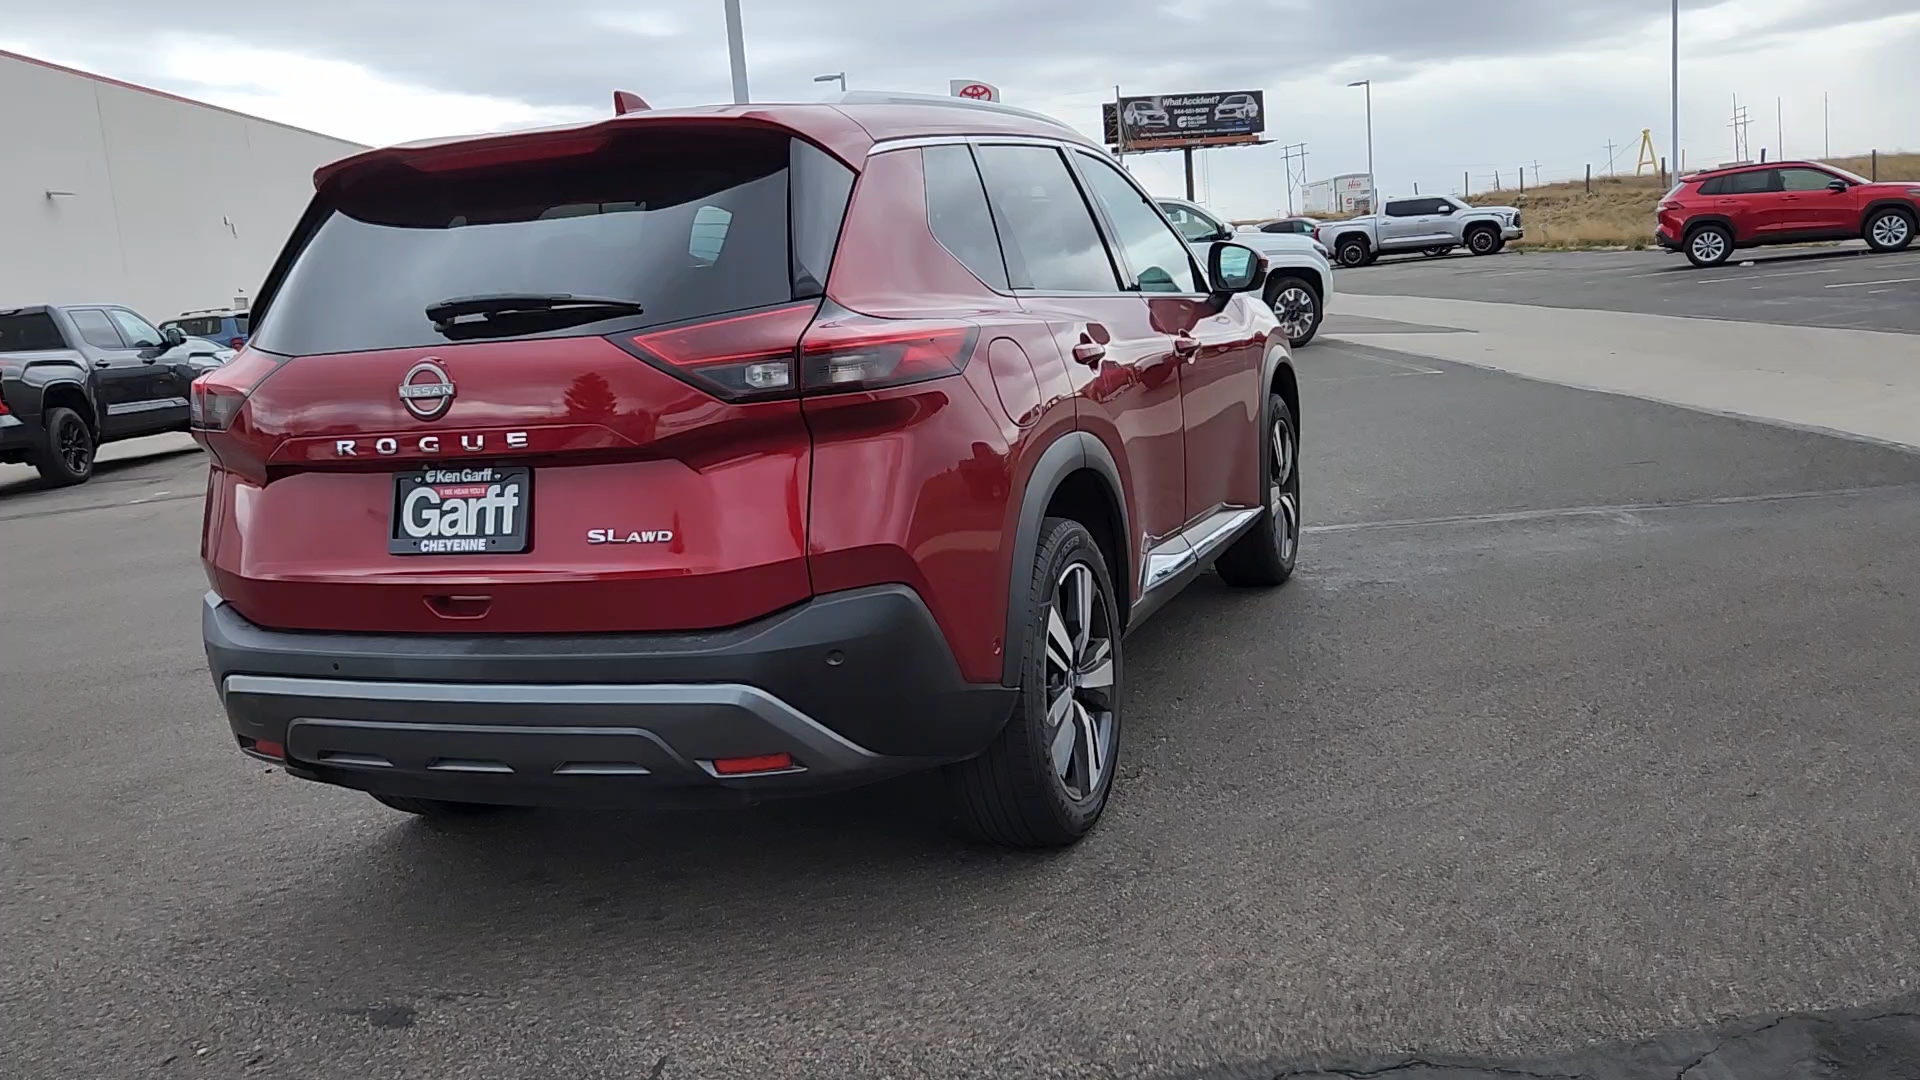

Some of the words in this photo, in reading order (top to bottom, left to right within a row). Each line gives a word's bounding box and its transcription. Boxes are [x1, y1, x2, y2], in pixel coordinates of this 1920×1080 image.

[1162, 97, 1182, 107] What
[1183, 95, 1220, 106] Accident?
[400, 386, 453, 397] NISSAN
[336, 432, 528, 457] ROGUE
[436, 470, 460, 482] Ken
[461, 468, 492, 482] Garff
[402, 483, 519, 537] Garff
[420, 538, 487, 552] CHEYENNE
